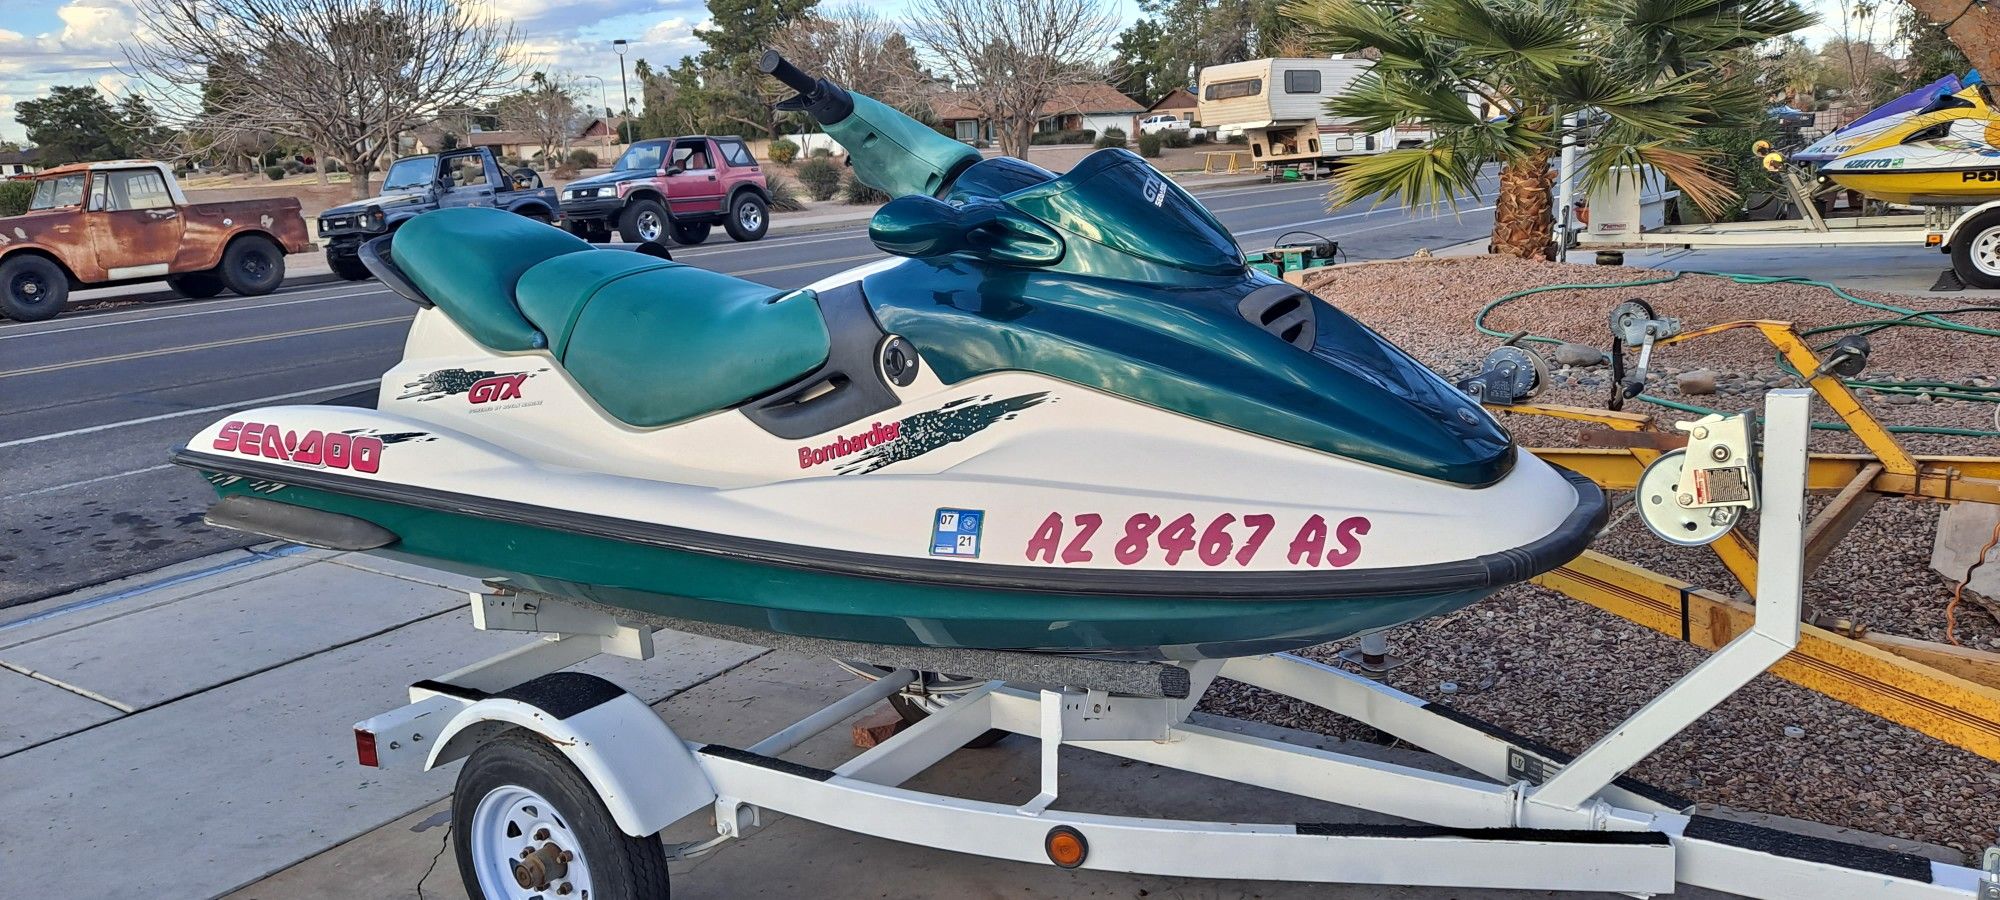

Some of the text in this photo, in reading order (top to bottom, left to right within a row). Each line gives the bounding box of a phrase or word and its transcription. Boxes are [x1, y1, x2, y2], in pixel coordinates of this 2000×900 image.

[1143, 174, 1161, 203] GTX
[1962, 171, 2000, 182] PO
[468, 373, 528, 404] GTX
[798, 421, 901, 469] Bombardier
[941, 514, 955, 525] 07
[959, 536, 972, 547] 21
[1025, 511, 1372, 568] AZ 8467 AS
